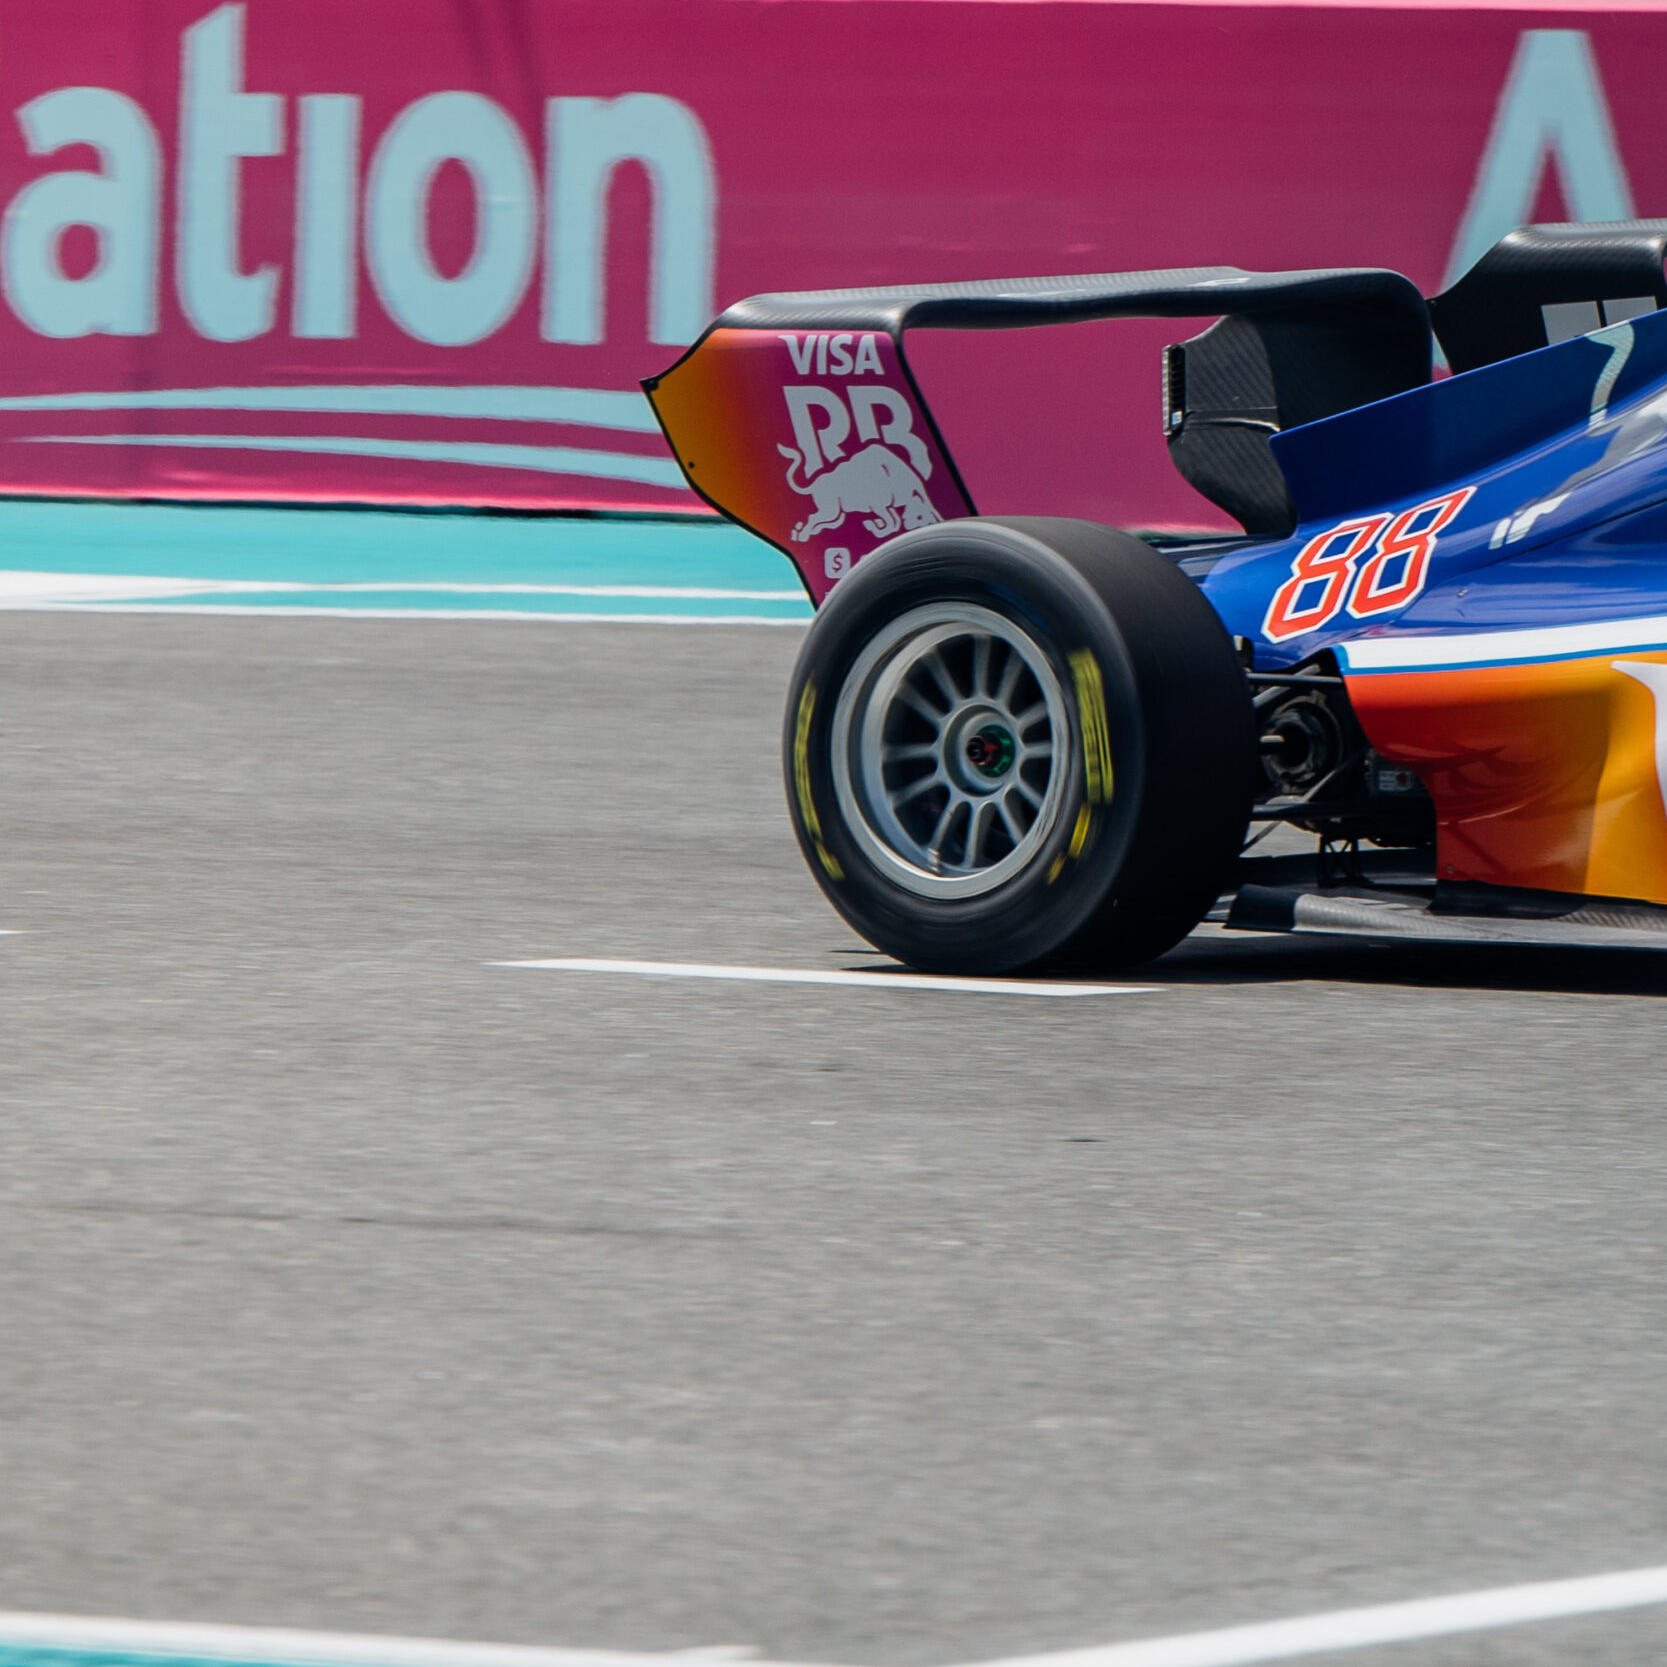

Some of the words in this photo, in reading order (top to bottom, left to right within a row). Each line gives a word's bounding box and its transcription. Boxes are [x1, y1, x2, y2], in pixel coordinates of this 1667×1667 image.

[3, 2, 718, 347] ation
[777, 333, 886, 376] VISA
[1262, 485, 1478, 644] 88
